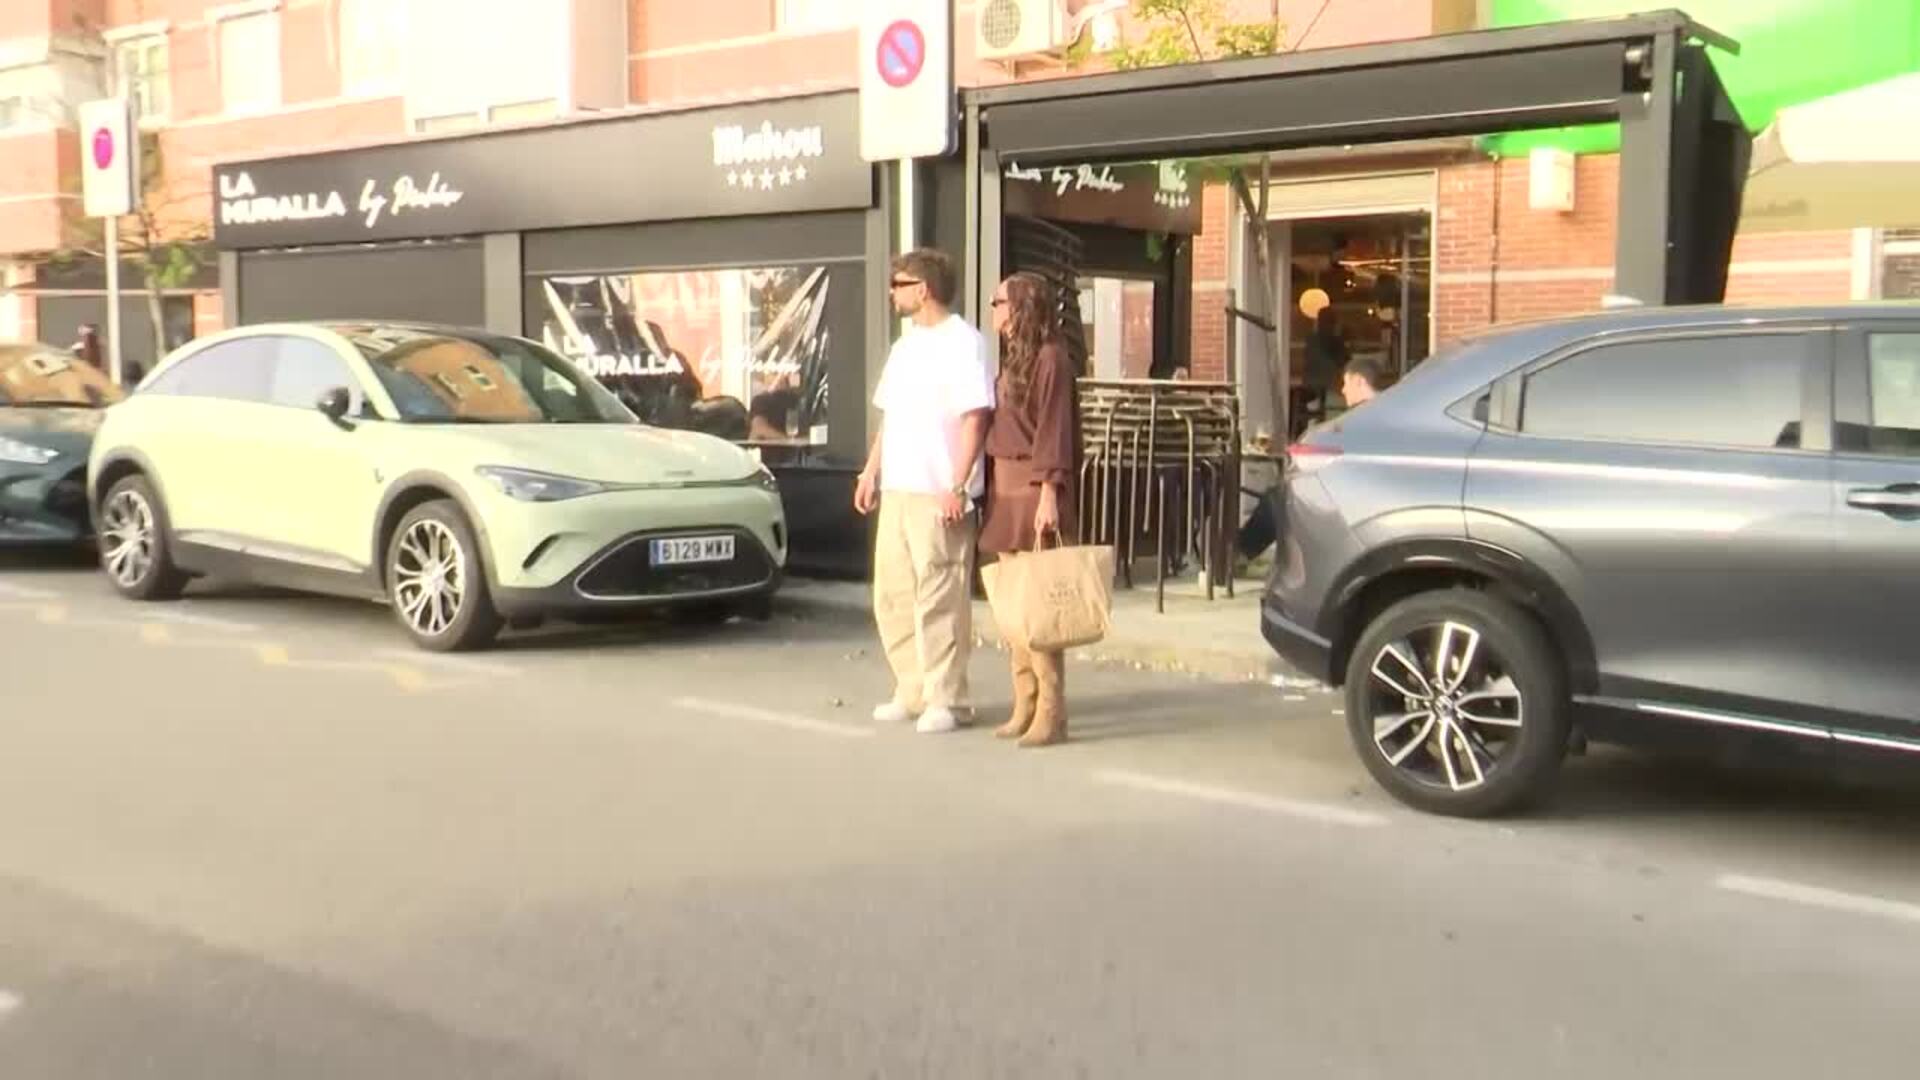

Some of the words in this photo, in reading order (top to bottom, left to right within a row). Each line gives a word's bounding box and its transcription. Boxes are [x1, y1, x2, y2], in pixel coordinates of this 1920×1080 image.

[220, 172, 256, 199] LA
[221, 191, 347, 225] MURALLA
[359, 179, 388, 229] by
[564, 333, 598, 355] LA
